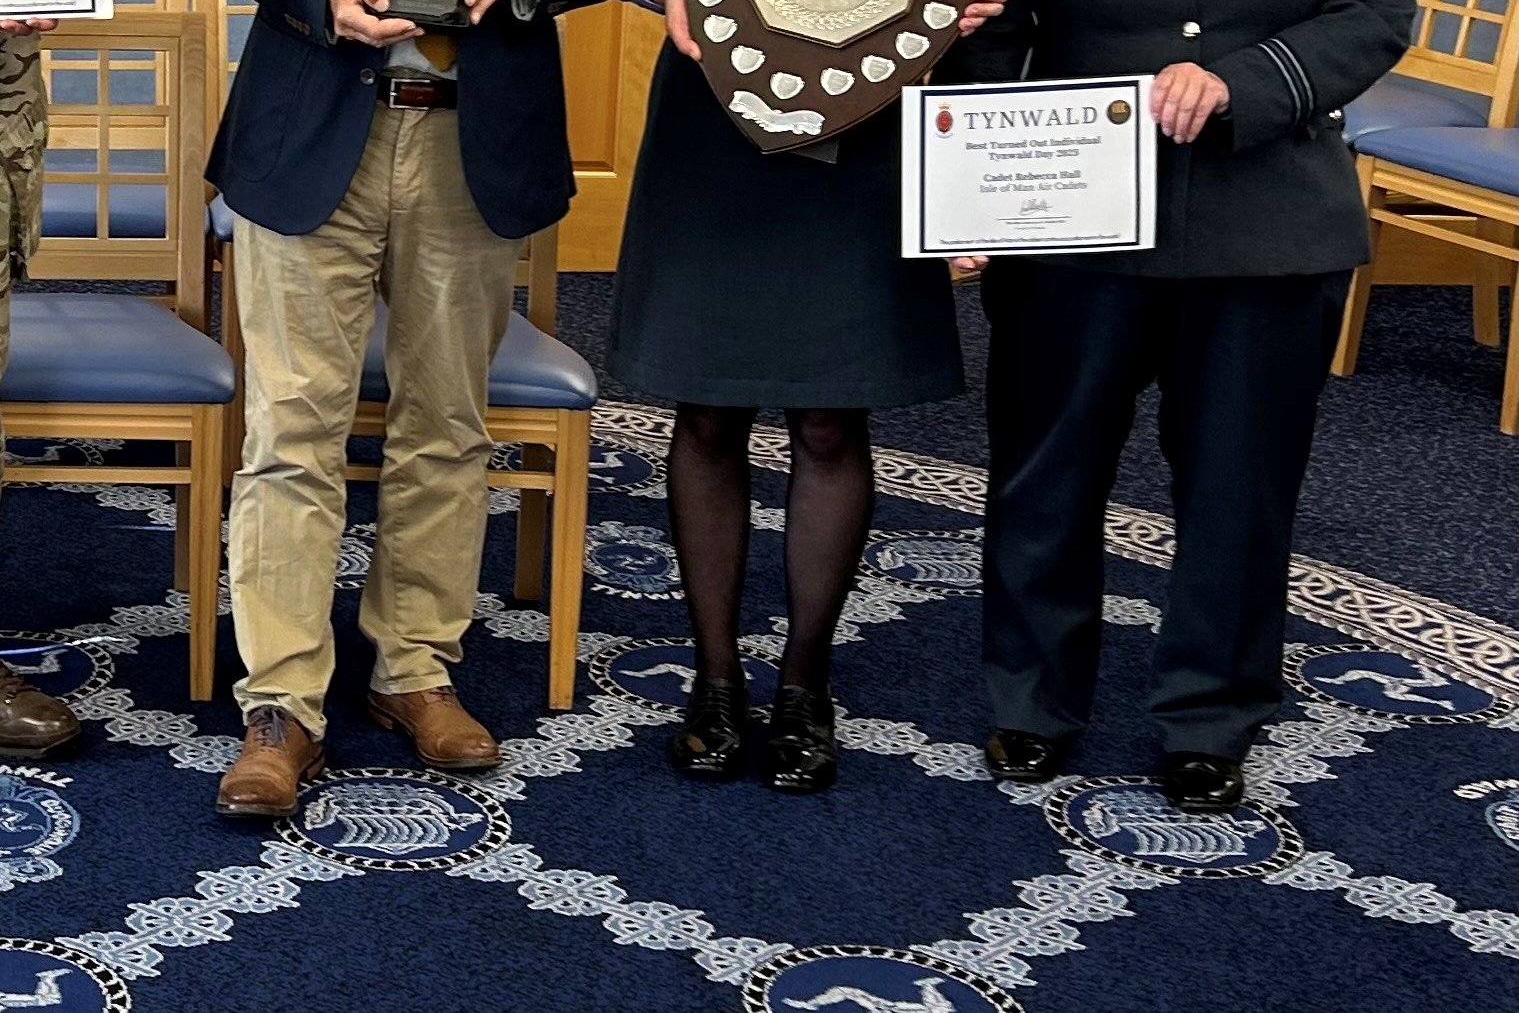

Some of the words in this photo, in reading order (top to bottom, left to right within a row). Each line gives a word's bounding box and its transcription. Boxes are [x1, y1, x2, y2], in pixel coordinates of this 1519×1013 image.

[964, 106, 1098, 129] TYNWALD
[966, 142, 987, 150] Best
[989, 140, 1027, 149] Turned
[1029, 139, 1047, 147] Out
[1049, 136, 1102, 147] Individual
[988, 151, 1032, 162] Tynwald
[1034, 150, 1054, 159] Day
[983, 172, 1013, 182] Cadet
[980, 184, 998, 193] Isle
[999, 183, 1011, 193] of
[1012, 183, 1035, 192] Man
[1037, 182, 1053, 191] Air
[1054, 181, 1088, 190] Cadets
[590, 583, 686, 600] TYNWA
[1452, 778, 1519, 800] WALD
